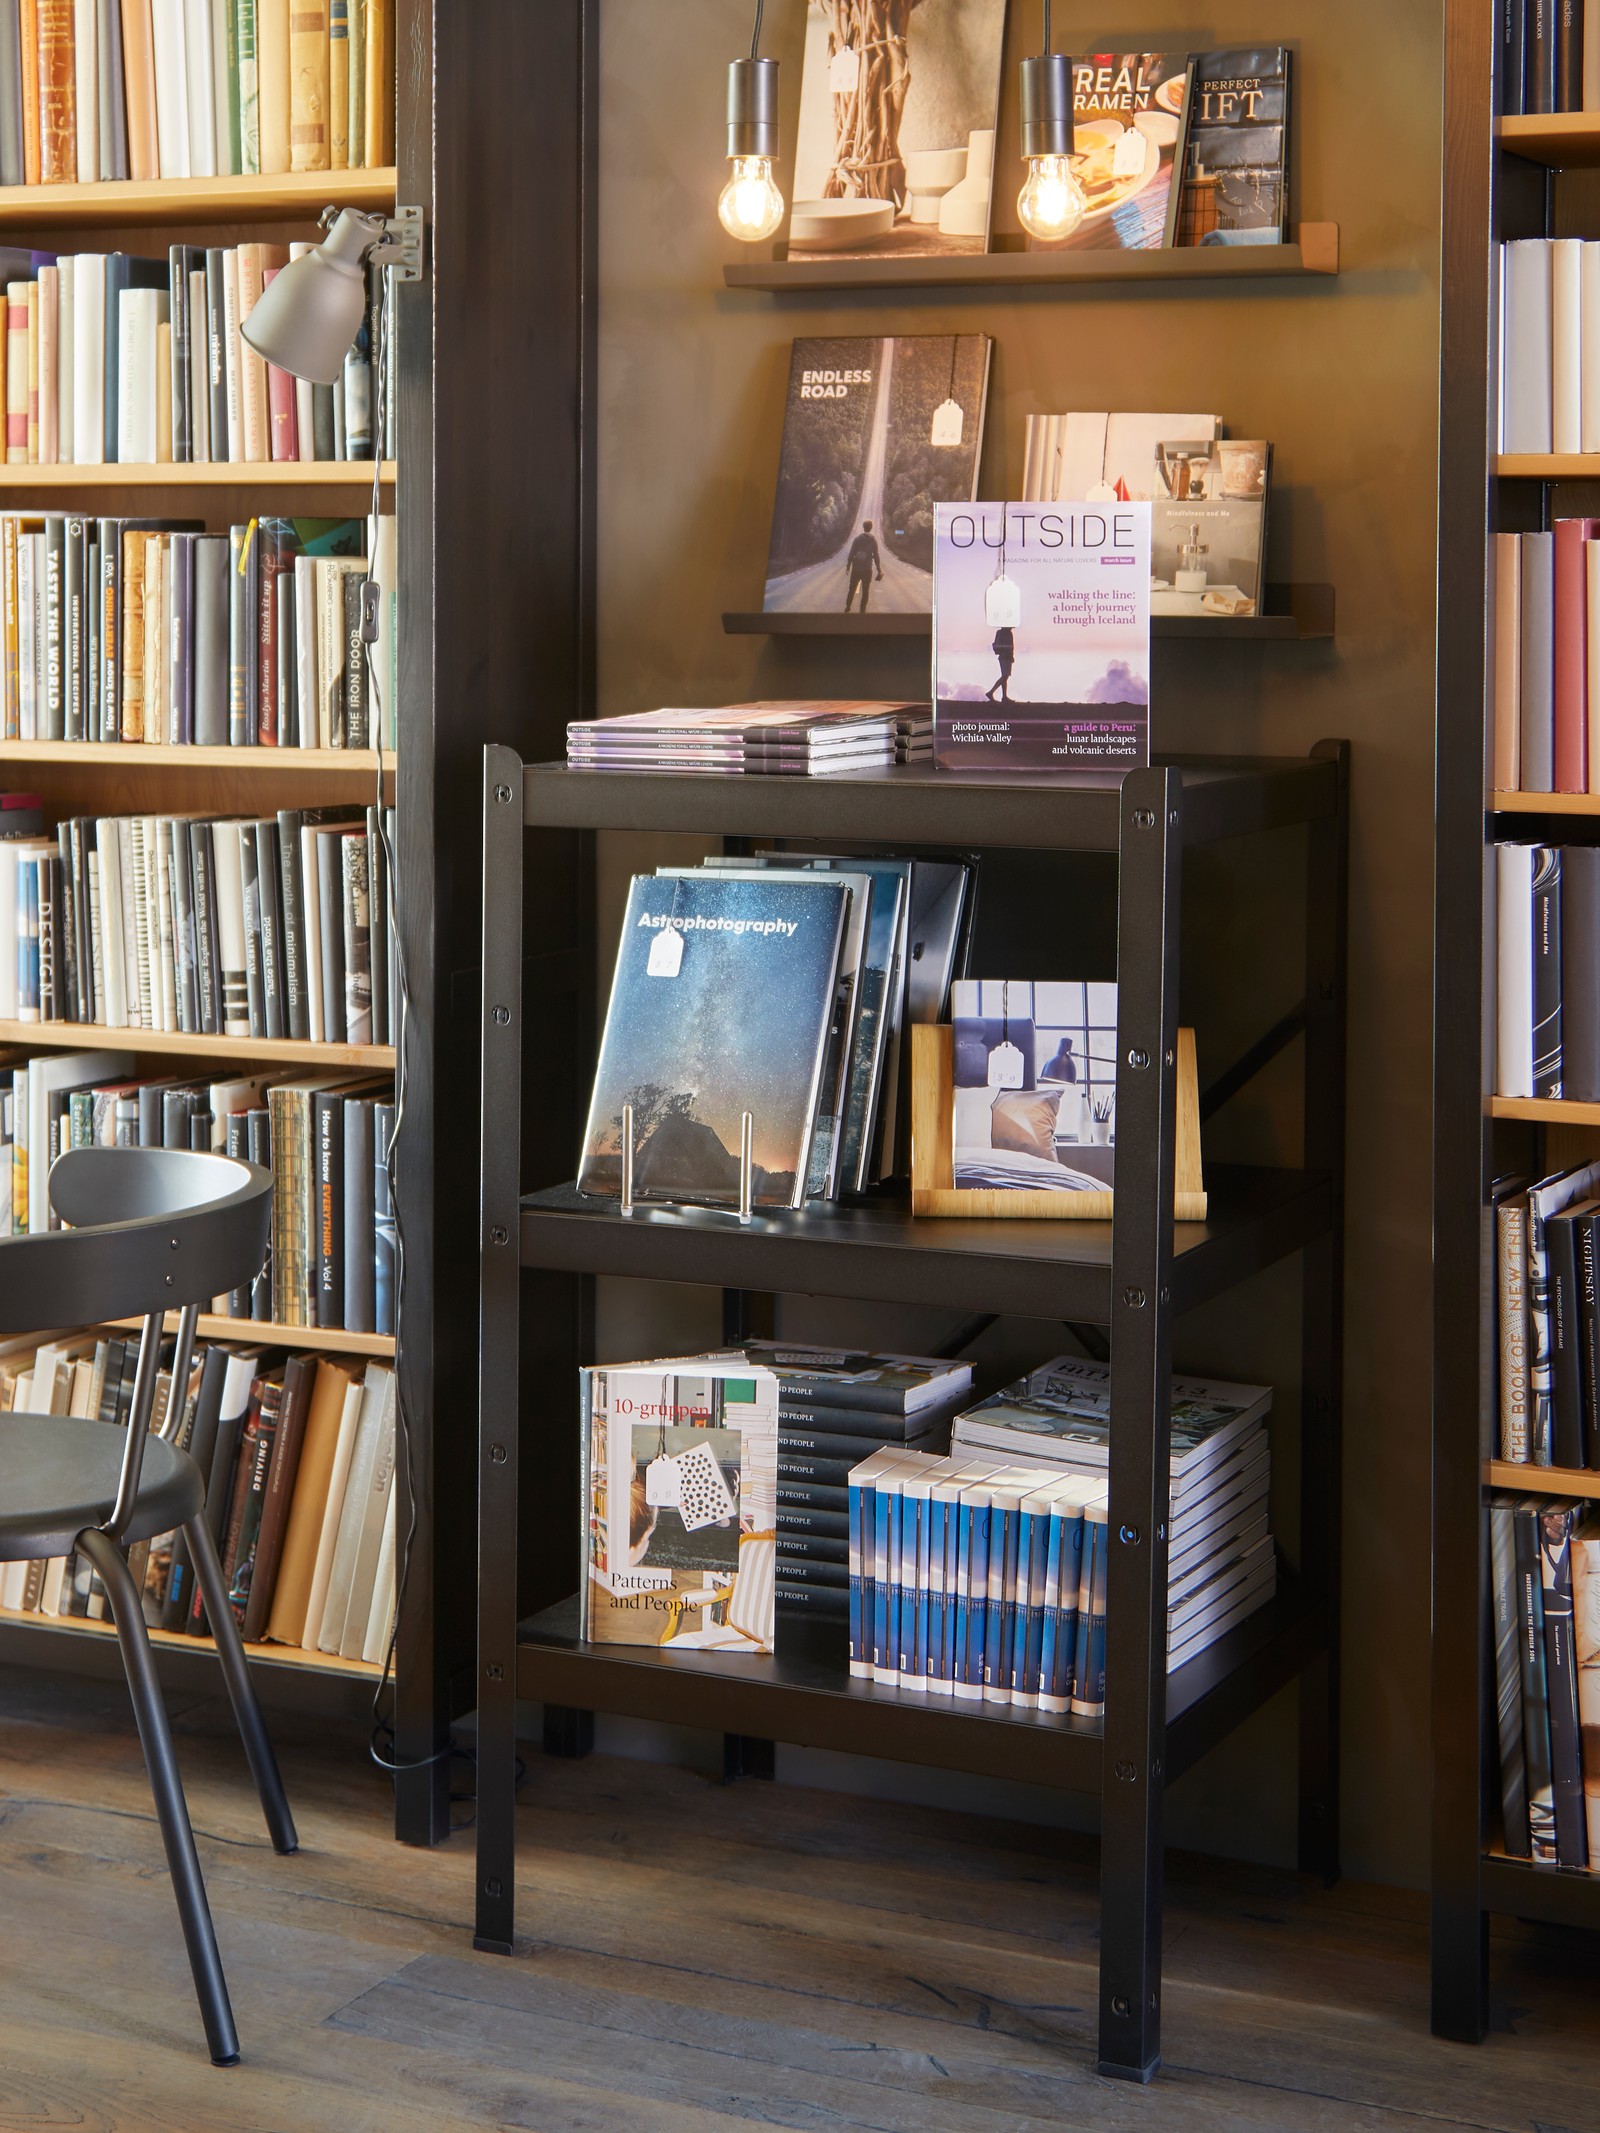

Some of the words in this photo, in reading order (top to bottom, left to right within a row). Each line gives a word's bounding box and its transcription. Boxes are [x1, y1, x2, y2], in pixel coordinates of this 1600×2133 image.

[1075, 67, 1151, 92] REAL
[1203, 78, 1261, 91] PERFECT
[1073, 93, 1149, 110] RAMEN
[1193, 89, 1265, 120] IFT
[371, 304, 379, 343] Together
[212, 333, 221, 385] minimalism
[371, 344, 379, 354] in
[371, 355, 379, 365] all
[802, 369, 872, 384] ENDLESS
[248, 371, 257, 412] ELLROY
[800, 384, 848, 398] ROAD
[230, 389, 238, 422] JAGGER
[249, 415, 258, 451] JAMES
[1166, 509, 1205, 518] Mindfulness
[1206, 510, 1219, 518] and
[1220, 509, 1230, 518] Me
[950, 514, 1135, 549] OUTSIDE
[104, 560, 115, 579] Vol
[1103, 556, 1120, 564] march
[47, 549, 59, 604] TASTE
[261, 579, 272, 596] up
[326, 564, 334, 606] BLOMBERG
[261, 596, 270, 609] it
[1047, 589, 1090, 603] walking
[1092, 590, 1110, 600] the
[1112, 590, 1136, 600] line:
[1052, 603, 1059, 612] a
[1060, 602, 1093, 615] lonely
[1094, 602, 1136, 615] journey
[47, 607, 59, 643] THE
[104, 587, 115, 658] EVERYTHING
[261, 610, 271, 646] Stitch
[1052, 615, 1095, 628] through
[1097, 615, 1136, 625] Iceland
[89, 634, 97, 652] Life
[350, 628, 362, 670] DOOR
[89, 652, 97, 672] Wild
[47, 646, 60, 711] WORLD
[105, 659, 115, 690] know
[261, 658, 270, 694] Martin
[89, 680, 98, 706] Living
[105, 691, 115, 704] to
[350, 672, 361, 708] IRON
[105, 706, 115, 732] How
[261, 693, 271, 732] Roslyn
[349, 712, 360, 738] THE
[951, 722, 977, 733] photo
[977, 722, 1010, 733] journal:
[1063, 724, 1070, 732] a
[1070, 723, 1098, 734] guide
[1099, 724, 1109, 732] to
[1111, 723, 1136, 732] Peru:
[951, 733, 984, 743] Wichita
[985, 733, 1012, 745] Valley
[1051, 745, 1068, 755] and
[1069, 745, 1105, 755] volcanic
[1106, 746, 1137, 755] deserts
[1066, 734, 1089, 743] lunar
[1090, 734, 1136, 746] landscapes
[196, 851, 204, 872] Ease
[283, 841, 293, 867] The
[350, 846, 362, 893] Rustic
[197, 873, 205, 892] with
[284, 873, 295, 905] myth
[198, 893, 207, 918] World
[244, 885, 253, 924] WALKING
[199, 920, 207, 934] the
[285, 912, 296, 925] of
[637, 912, 799, 937] Astrophotography
[247, 926, 254, 935] ON
[263, 916, 272, 948] World
[38, 901, 53, 997] DESIGN
[200, 934, 210, 967] Explore
[264, 948, 273, 967] the
[1543, 945, 1550, 955] Me
[287, 930, 298, 1006] minimalism
[202, 969, 211, 993] Light:
[266, 967, 275, 998] Taste
[203, 994, 211, 1020] Travel
[73, 1104, 83, 1141] Survive
[322, 1109, 332, 1137] How
[322, 1137, 332, 1150] to
[322, 1151, 332, 1182] know
[321, 1183, 332, 1257] EVERYTHING
[322, 1265, 332, 1282] Vol
[322, 1282, 332, 1291] 4
[1508, 1267, 1521, 1311] NEW
[1581, 1227, 1595, 1307] NIGHTSKY
[1590, 1379, 1597, 1387] by
[1557, 1319, 1563, 1328] OF
[1509, 1334, 1524, 1358] OF
[787, 1386, 813, 1396] PEOPLE
[1510, 1364, 1525, 1415] BOOK
[284, 1391, 293, 1417] INVESTING
[613, 1398, 711, 1421] 10-gruppen
[788, 1411, 814, 1422] PEOPLE
[789, 1438, 815, 1448] PEOPLE
[1511, 1422, 1526, 1459] THE
[253, 1439, 269, 1492] DRIVING
[789, 1463, 815, 1474] PEOPLE
[273, 1471, 281, 1494] COUPLES
[785, 1490, 811, 1500] PEOPLE
[786, 1515, 811, 1525] PEOPLE
[782, 1540, 808, 1551] PEOPLE
[610, 1571, 678, 1592] Patterns
[782, 1567, 808, 1576] PEOPLE
[1498, 1567, 1506, 1600] SUSTAINABLE
[1525, 1573, 1534, 1614] UNDERSTANDING
[609, 1594, 641, 1610] and
[643, 1595, 699, 1617] People
[783, 1591, 809, 1601] PEOPLE
[1500, 1601, 1508, 1622] TRAVEL
[1526, 1615, 1535, 1625] THE
[1527, 1625, 1536, 1648] SWEDISH
[1528, 1649, 1536, 1663] SOUL
